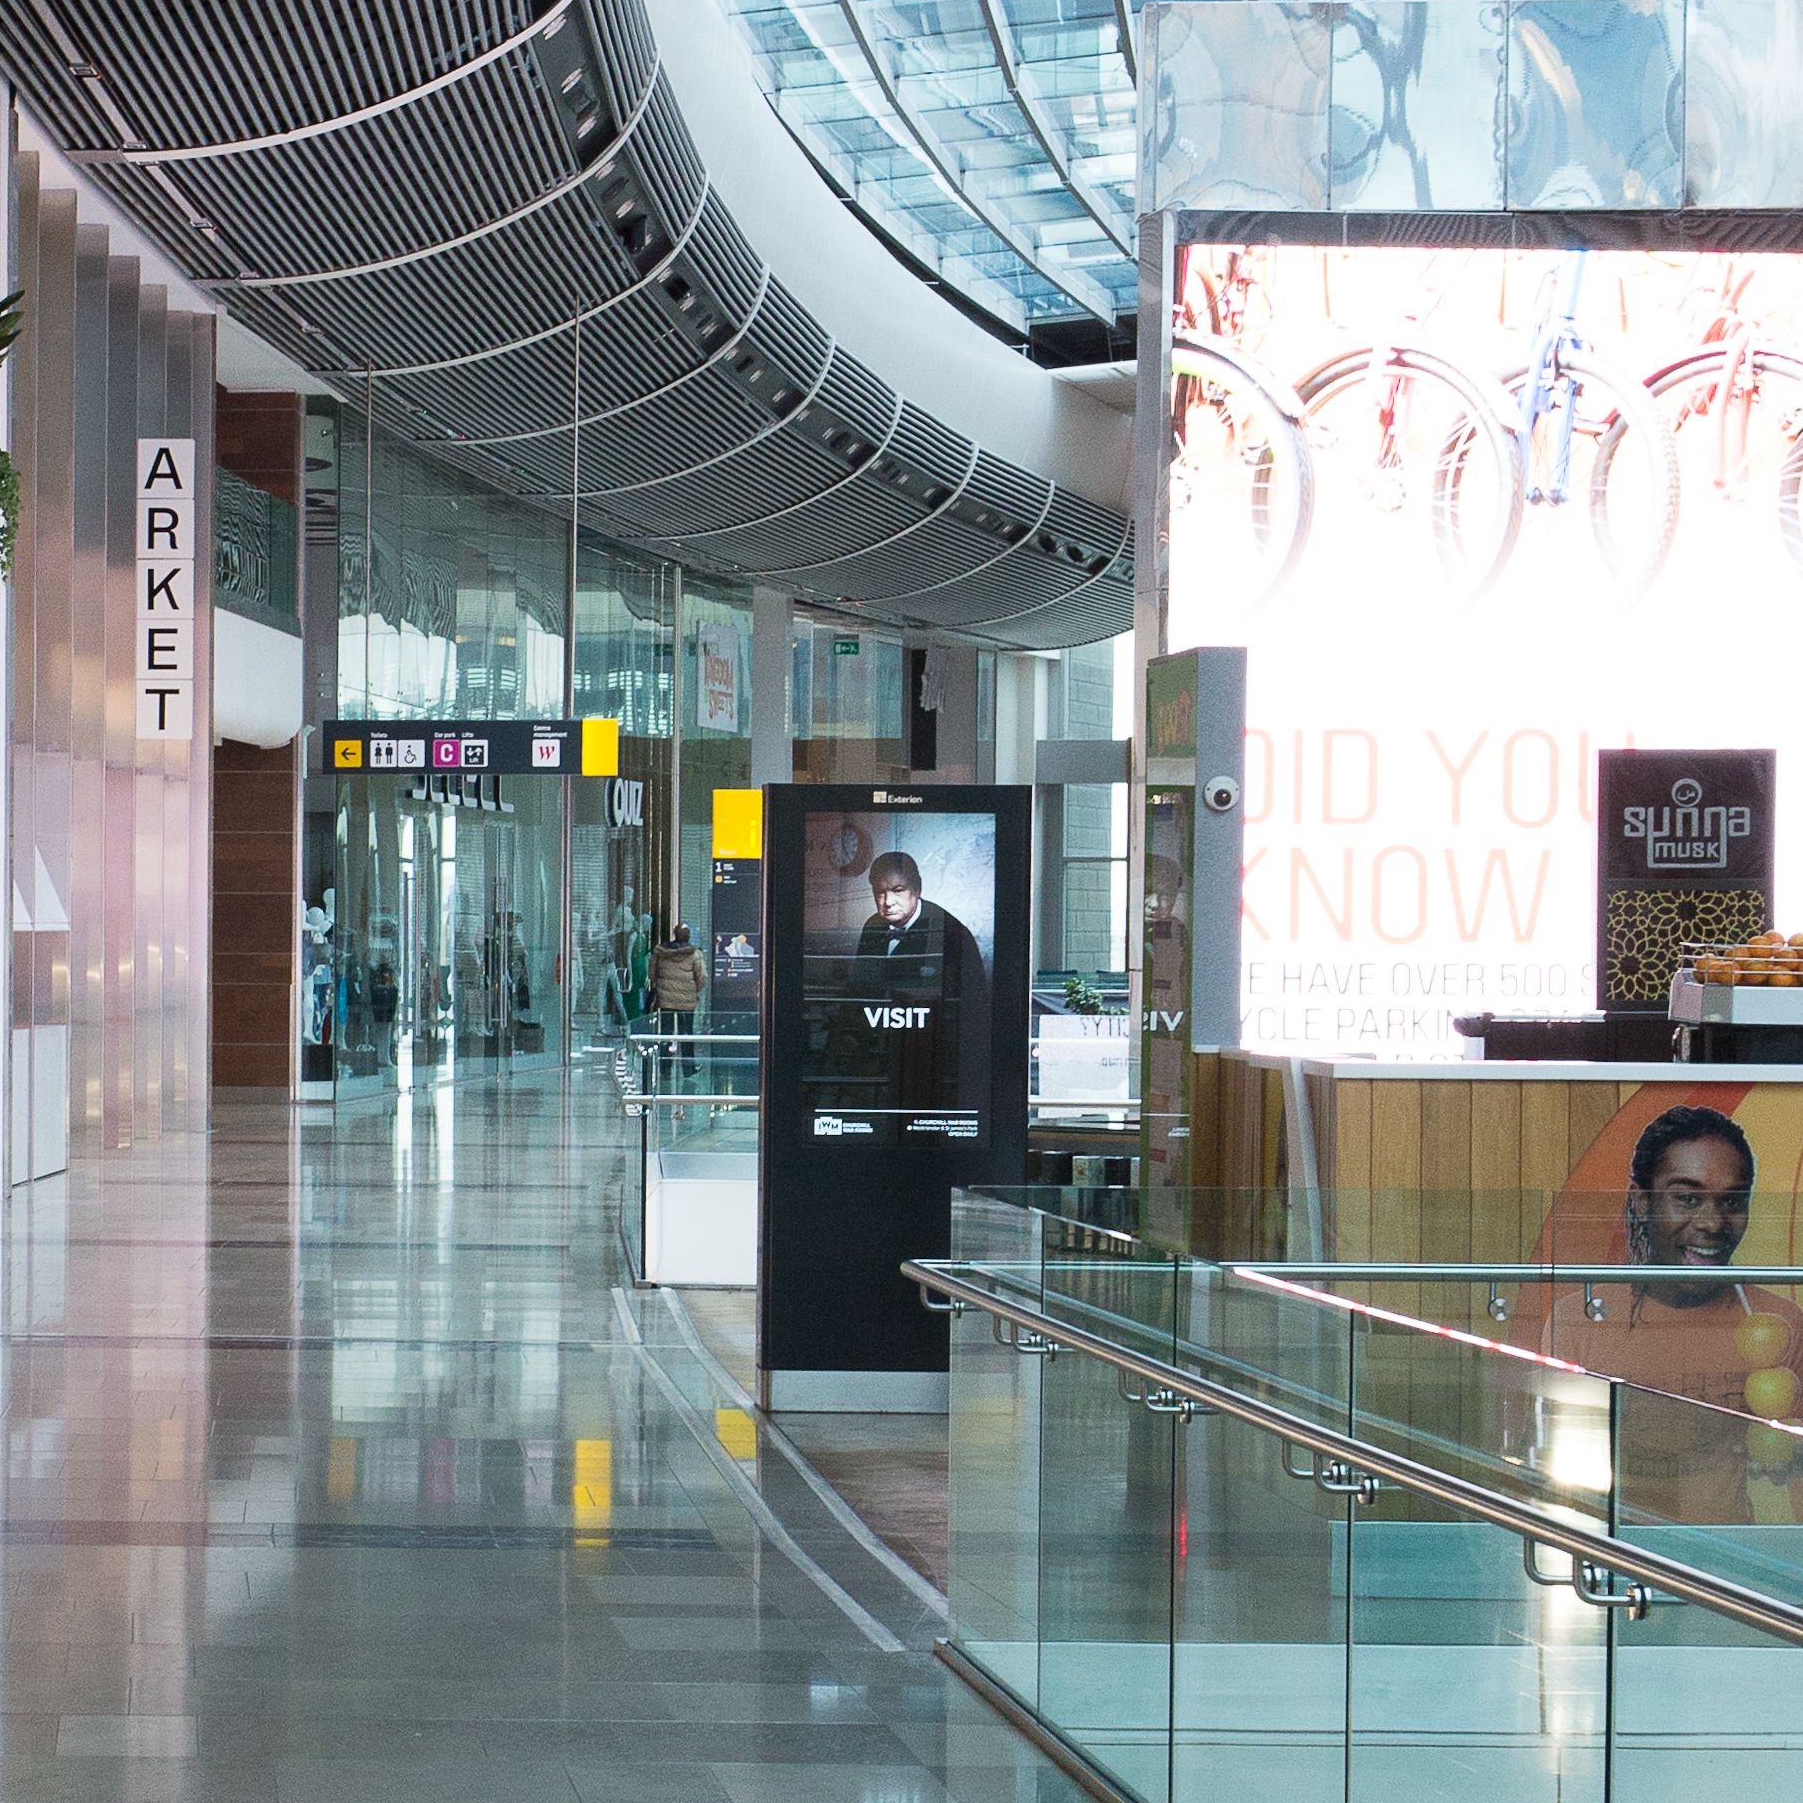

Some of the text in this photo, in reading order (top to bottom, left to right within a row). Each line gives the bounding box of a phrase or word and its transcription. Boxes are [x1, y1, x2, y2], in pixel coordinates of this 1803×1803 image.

[143, 446, 184, 731] ARKET
[440, 744, 454, 763] C
[613, 778, 644, 827] QUIZ
[1282, 962, 1377, 995] HAVE
[1392, 962, 1486, 996] OVER
[1500, 963, 1567, 997] 500
[863, 1007, 931, 1029] VISIT
